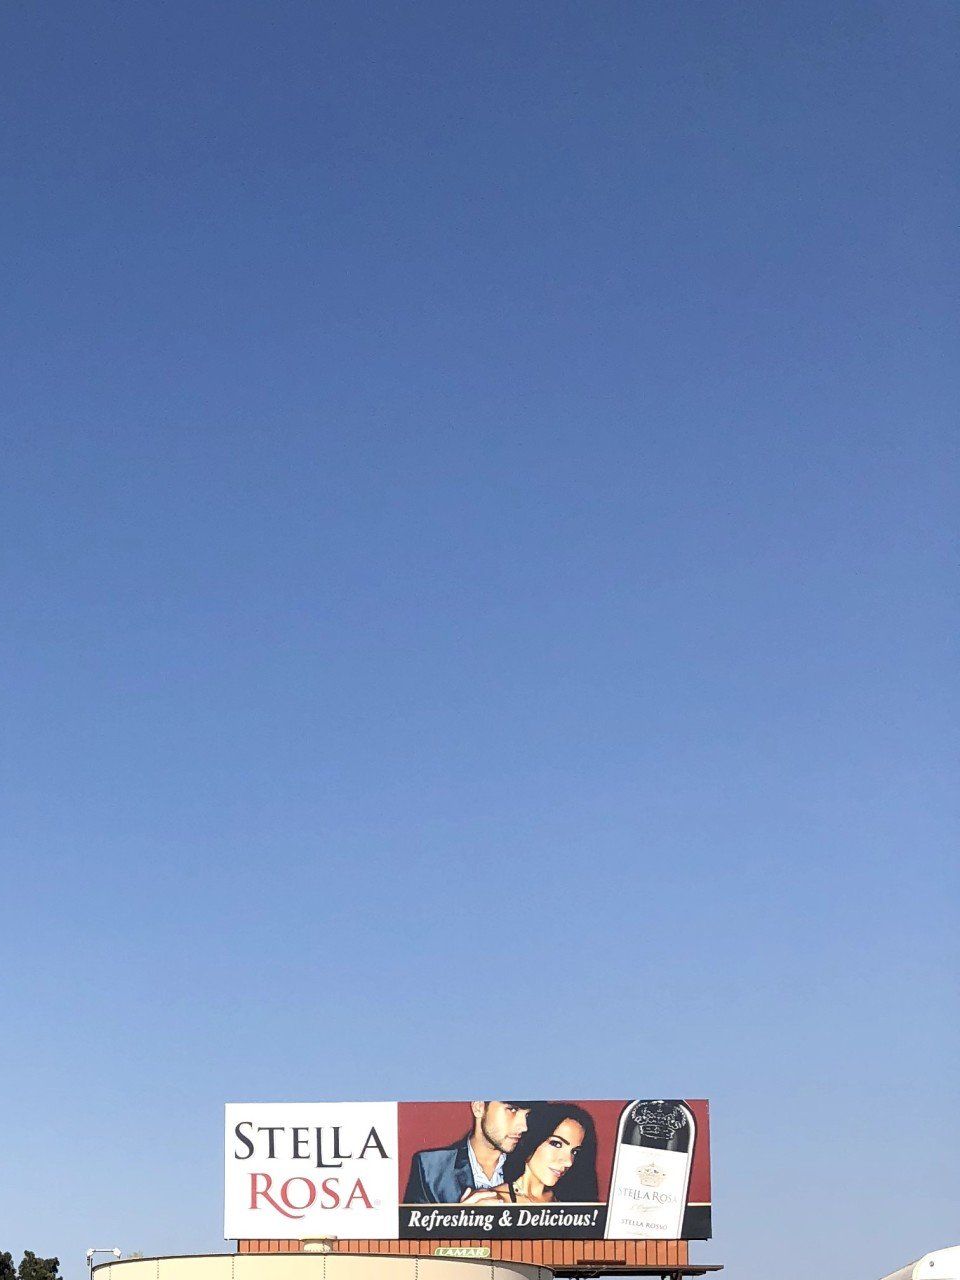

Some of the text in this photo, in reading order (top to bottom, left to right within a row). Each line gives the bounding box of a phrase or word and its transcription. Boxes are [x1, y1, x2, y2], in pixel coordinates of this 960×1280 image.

[234, 1121, 390, 1168] STELLA
[248, 1172, 375, 1219] ROSA
[407, 1209, 599, 1231] Refreshing & Delicious!
